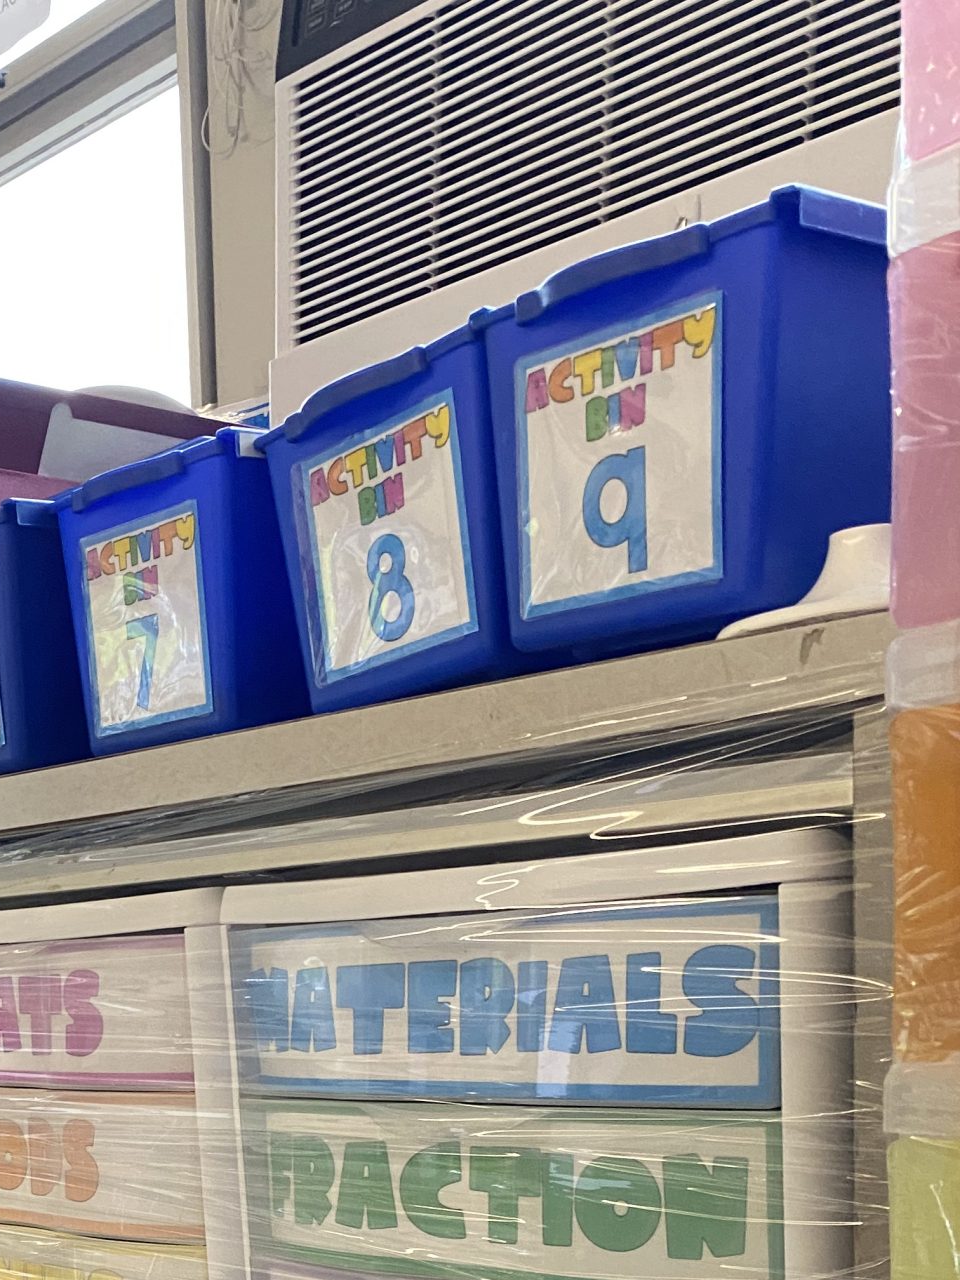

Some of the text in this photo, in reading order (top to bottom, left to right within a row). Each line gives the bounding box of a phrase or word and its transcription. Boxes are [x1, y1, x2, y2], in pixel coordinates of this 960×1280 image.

[525, 306, 716, 415] ACTIVITY
[309, 404, 451, 506] ACTIVITY
[585, 383, 646, 442] BIN
[86, 513, 195, 581] ACTIVITY
[357, 472, 405, 526] BIN
[367, 533, 415, 642] 8
[126, 613, 159, 710] 7
[250, 944, 759, 1058] MATERIALS
[269, 1131, 749, 1260] FRACTION
